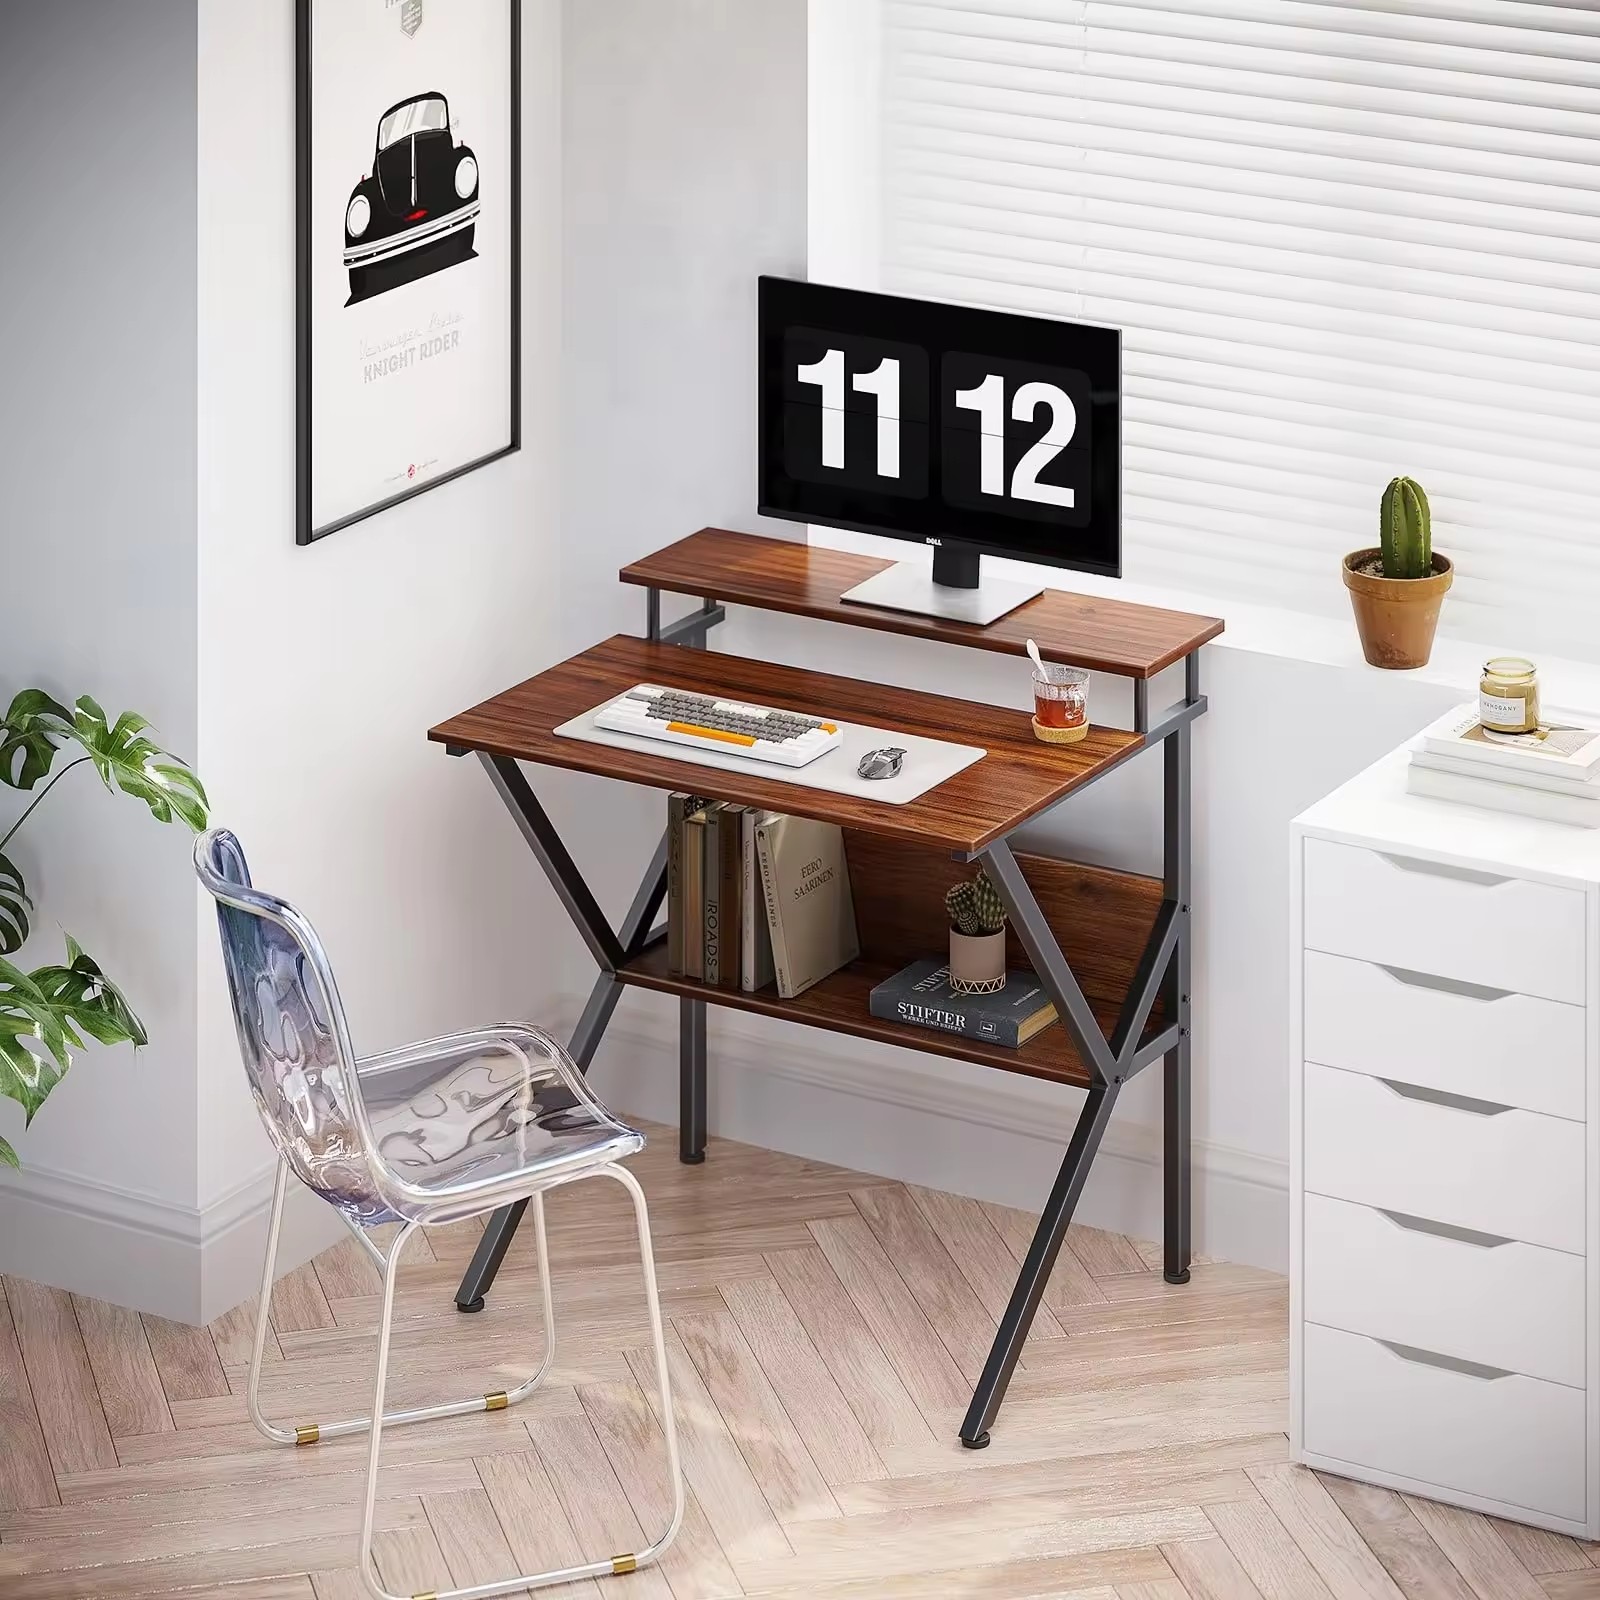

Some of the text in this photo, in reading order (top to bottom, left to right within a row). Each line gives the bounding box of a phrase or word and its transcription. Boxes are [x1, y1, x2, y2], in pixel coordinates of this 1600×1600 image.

[363, 346, 416, 384] KNIGHT
[420, 330, 460, 360] RIDER
[798, 349, 1077, 508] 11 12
[794, 867, 834, 900] SAARINEN
[801, 858, 822, 878] EERO
[761, 851, 778, 928] EERO SAARINEN
[911, 963, 950, 992] STIFTE
[897, 1001, 967, 1028] STIFTER
